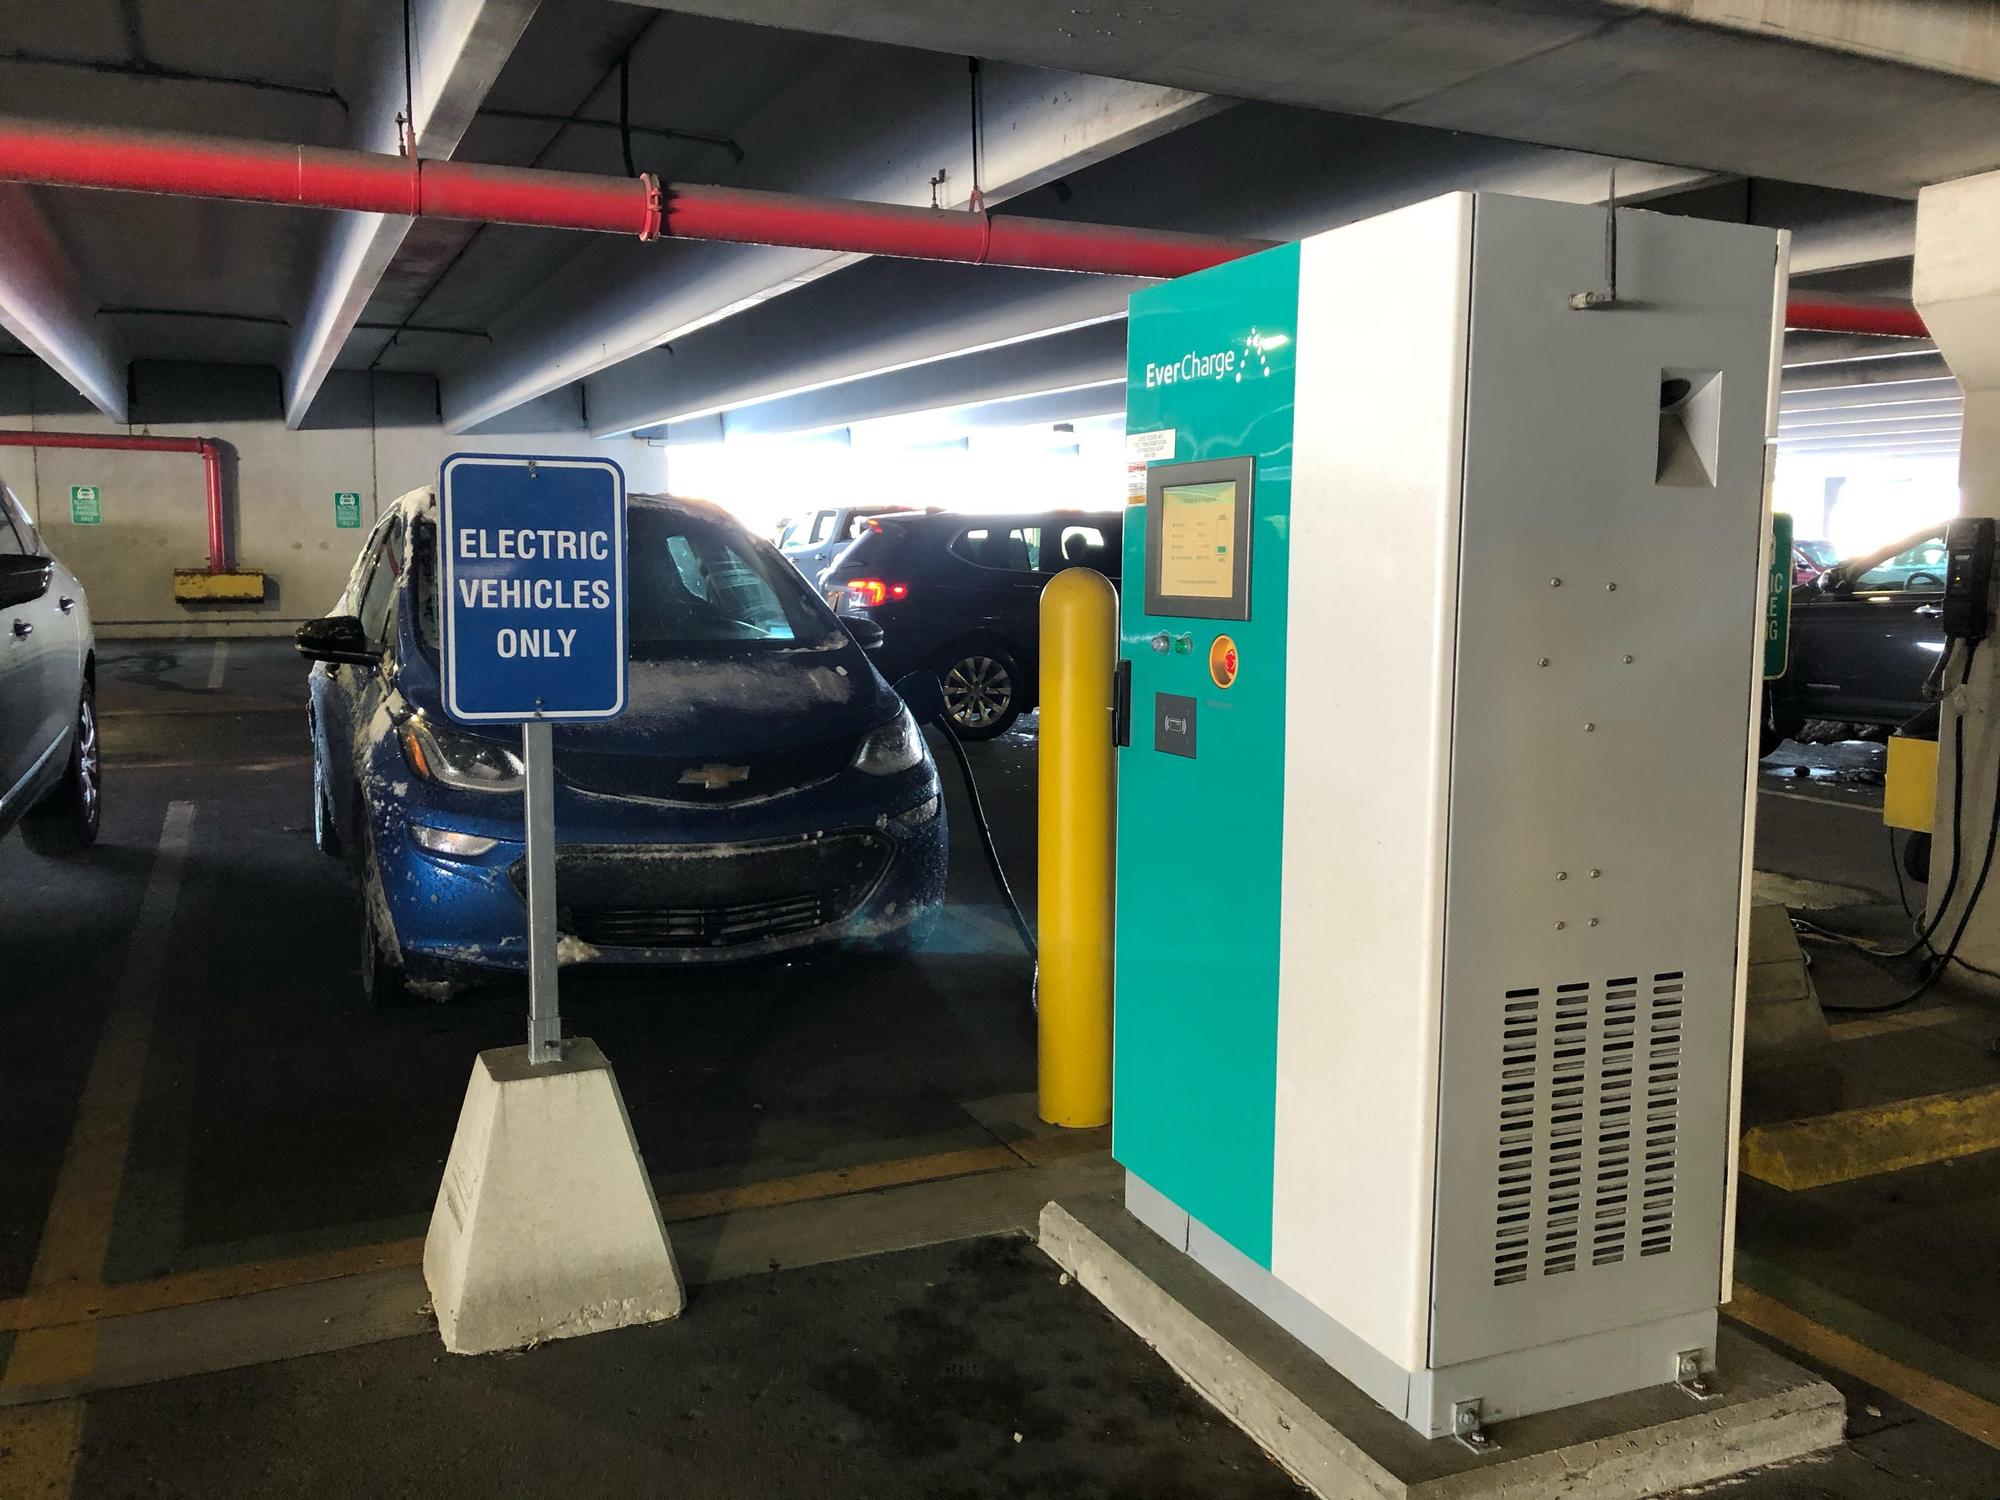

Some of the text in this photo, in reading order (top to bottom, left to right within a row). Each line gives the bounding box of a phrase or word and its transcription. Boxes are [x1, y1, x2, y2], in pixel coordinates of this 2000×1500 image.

[1146, 350, 1235, 388] EverCharge
[459, 528, 609, 561] ELECTRIC
[459, 579, 610, 610] VEHICLES
[496, 628, 577, 659] ONLY
